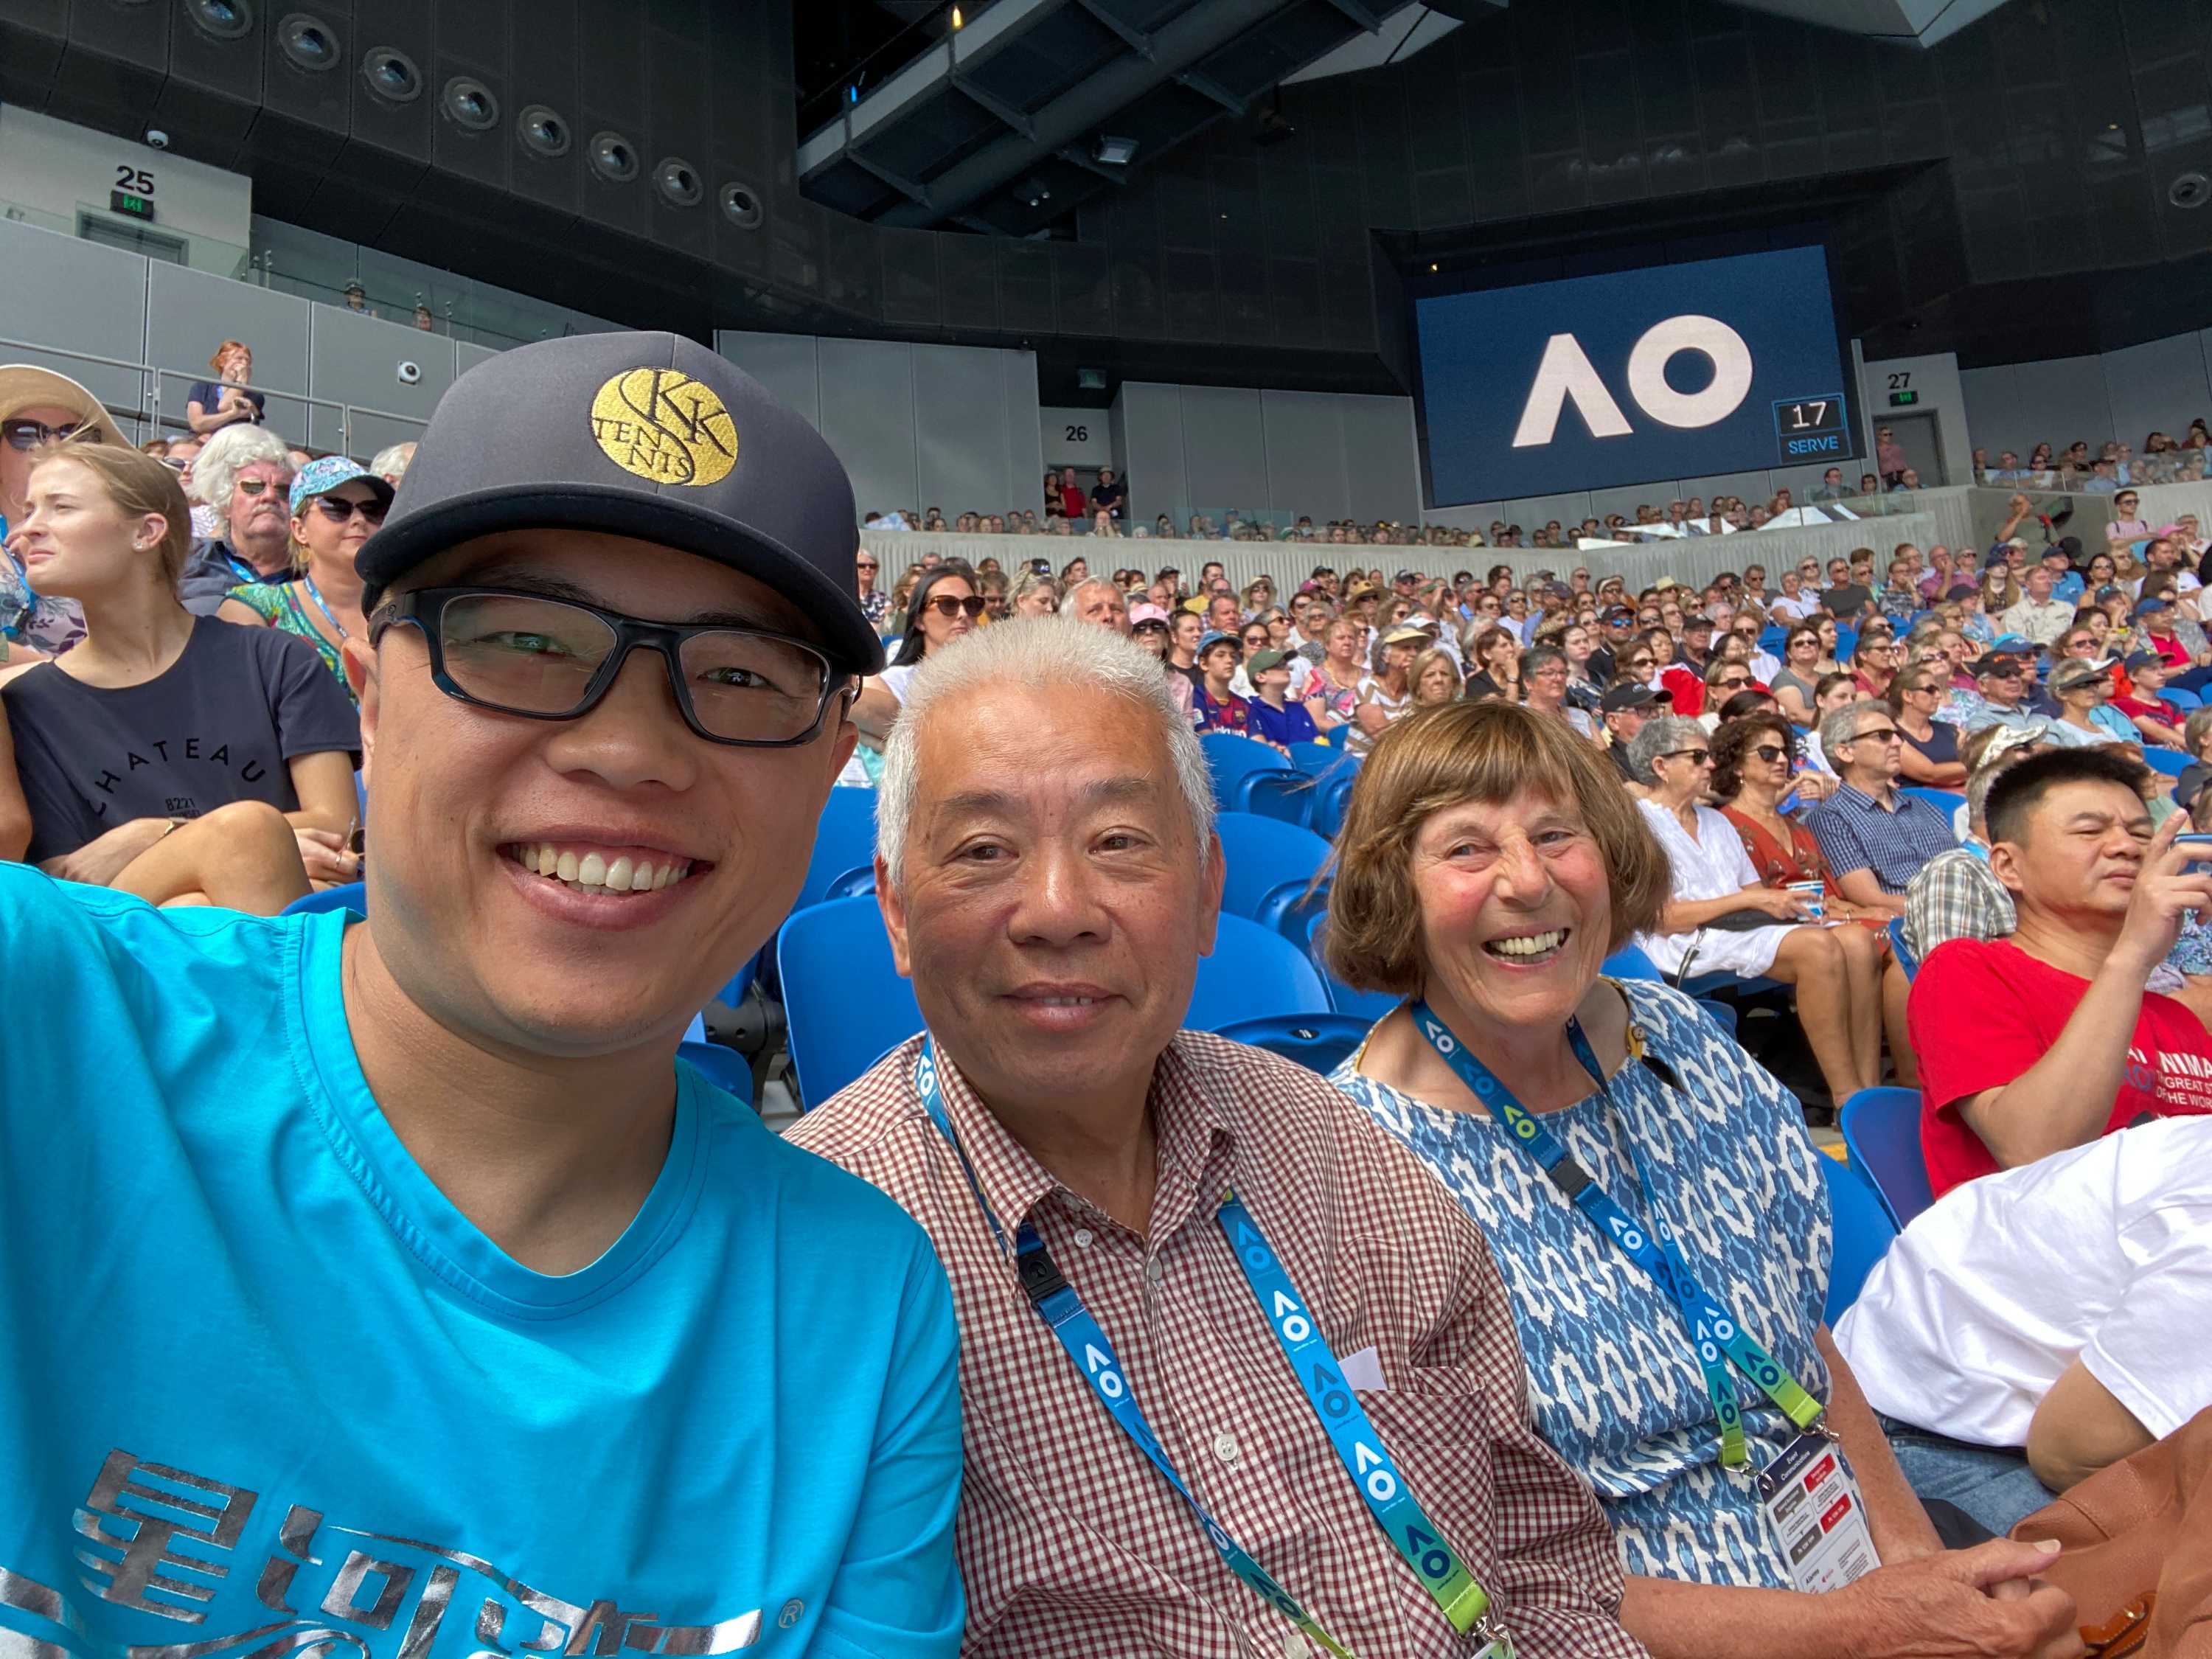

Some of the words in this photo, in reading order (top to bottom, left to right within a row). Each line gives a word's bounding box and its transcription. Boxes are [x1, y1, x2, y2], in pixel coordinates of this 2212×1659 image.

[116, 165, 154, 195] 25
[1512, 314, 1753, 448] AO
[1887, 372, 1911, 390] 27
[1792, 400, 1827, 429] 17
[1065, 425, 1088, 442] 26
[1787, 434, 1840, 455] SERVE
[1426, 1020, 1454, 1052] AO
[2165, 1076, 2203, 1093] GREAT
[1503, 1105, 1535, 1138] AO
[1609, 1217, 1642, 1250] AO
[1274, 1290, 1310, 1341] AO
[1697, 1319, 1717, 1363] AO
[1085, 1343, 1123, 1398] AO
[1745, 1351, 1779, 1385] AO
[1313, 1362, 1351, 1419] AO
[1717, 1380, 1736, 1425] AO
[1354, 1441, 1396, 1501] AO
[1405, 1524, 1450, 1579] AO
